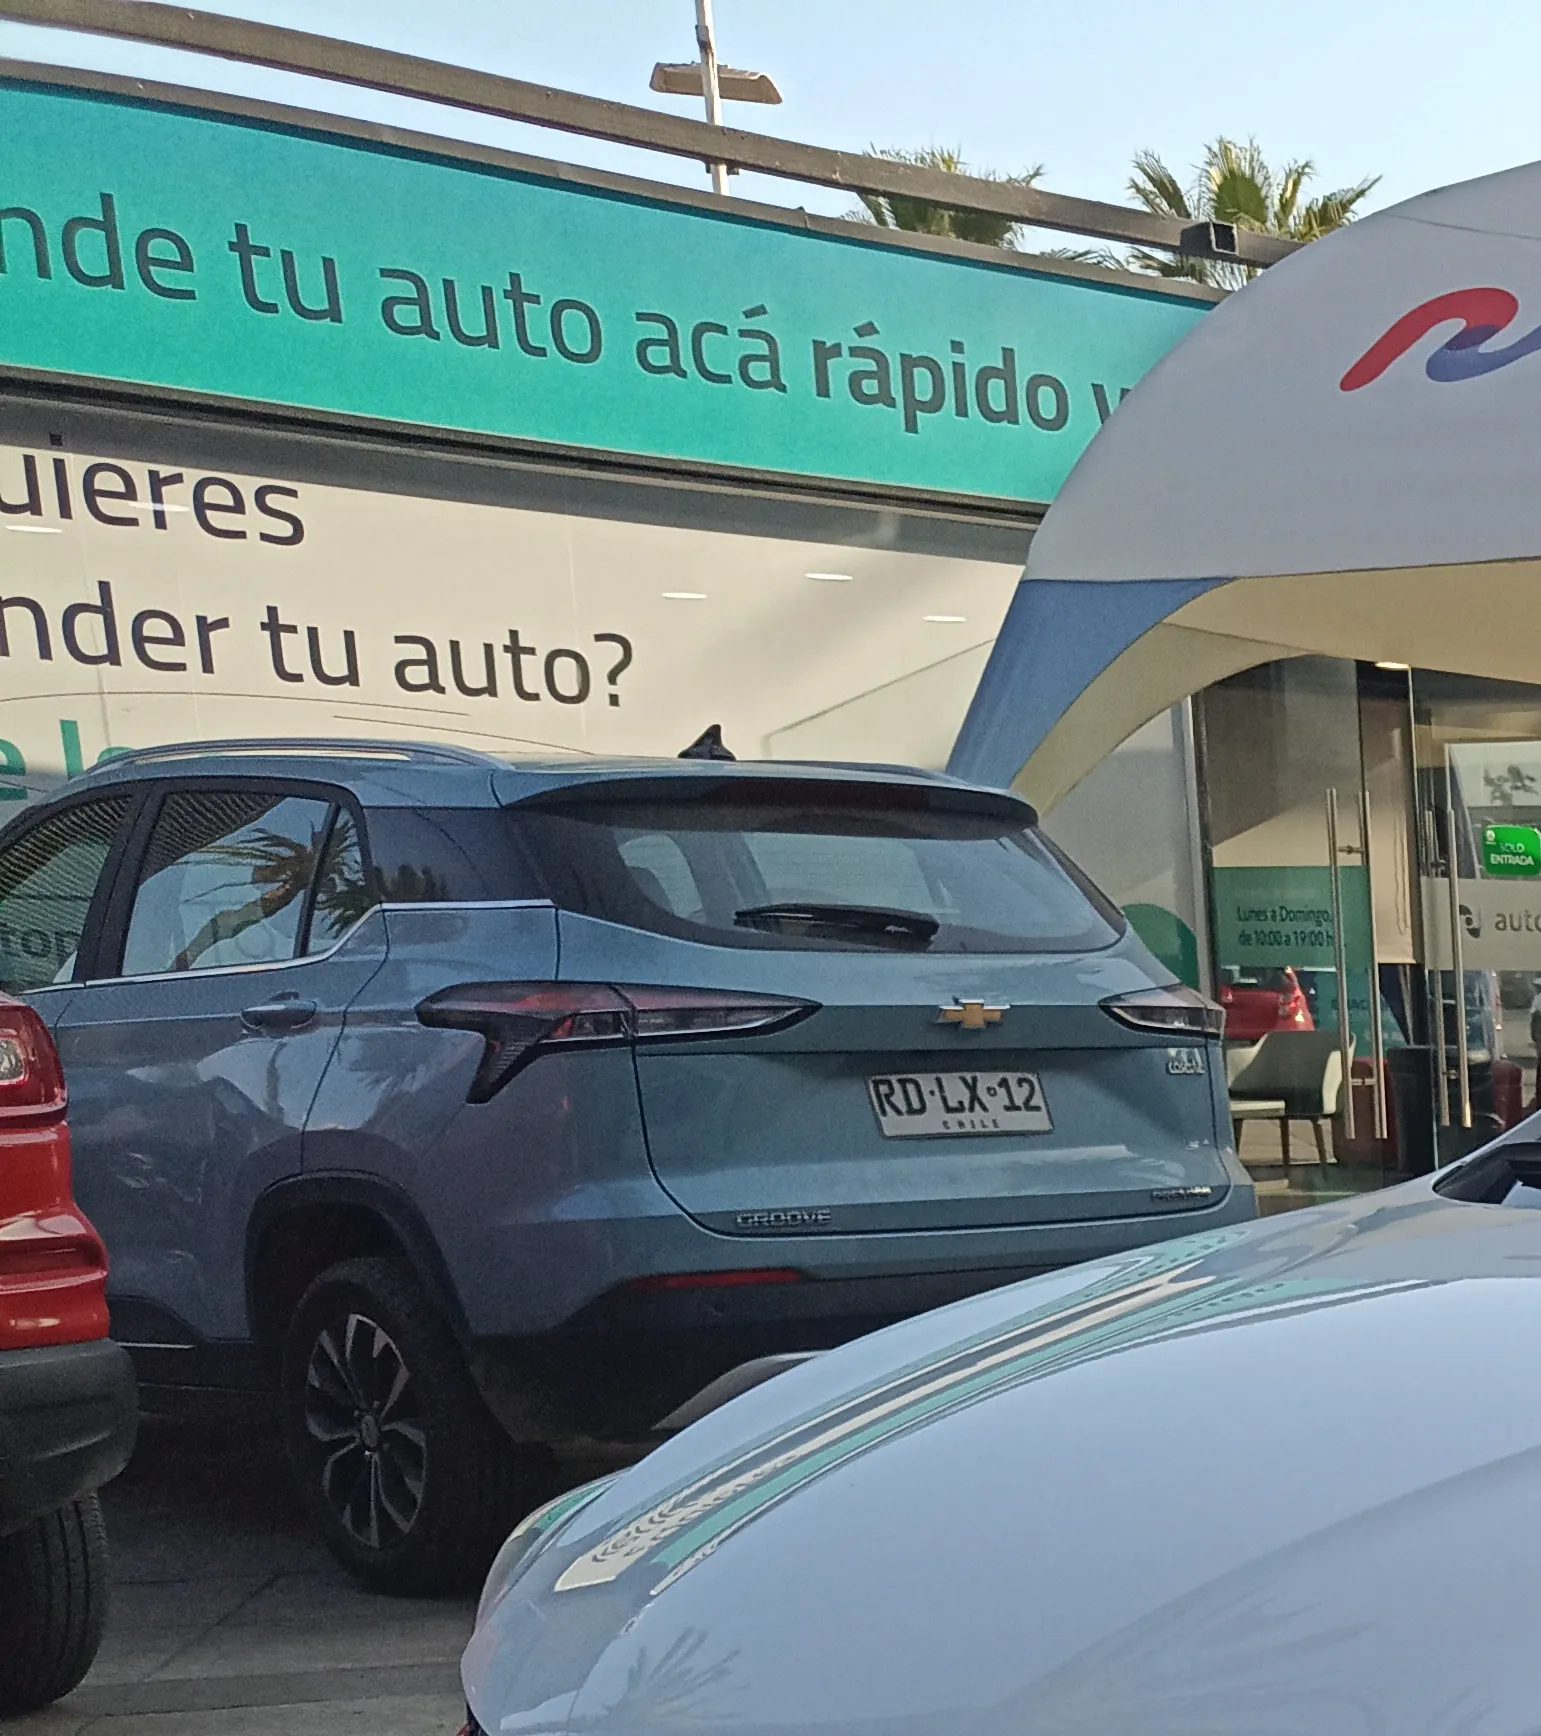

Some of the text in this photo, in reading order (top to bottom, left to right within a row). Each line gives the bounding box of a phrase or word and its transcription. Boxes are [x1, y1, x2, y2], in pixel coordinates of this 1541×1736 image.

[226, 222, 344, 324] tu
[378, 271, 603, 365] auto
[634, 304, 788, 394] acá
[812, 320, 1070, 434] rápido
[260, 605, 361, 688] tu
[394, 629, 634, 707] auto?
[1490, 853, 1535, 866] ENTRADA
[1236, 905, 1269, 922] Lunes
[1270, 908, 1278, 922] a
[1238, 929, 1252, 946] de
[1293, 929, 1325, 947] 19:00
[942, 1119, 1001, 1131] CHILE
[736, 1208, 831, 1227] GROOVE
